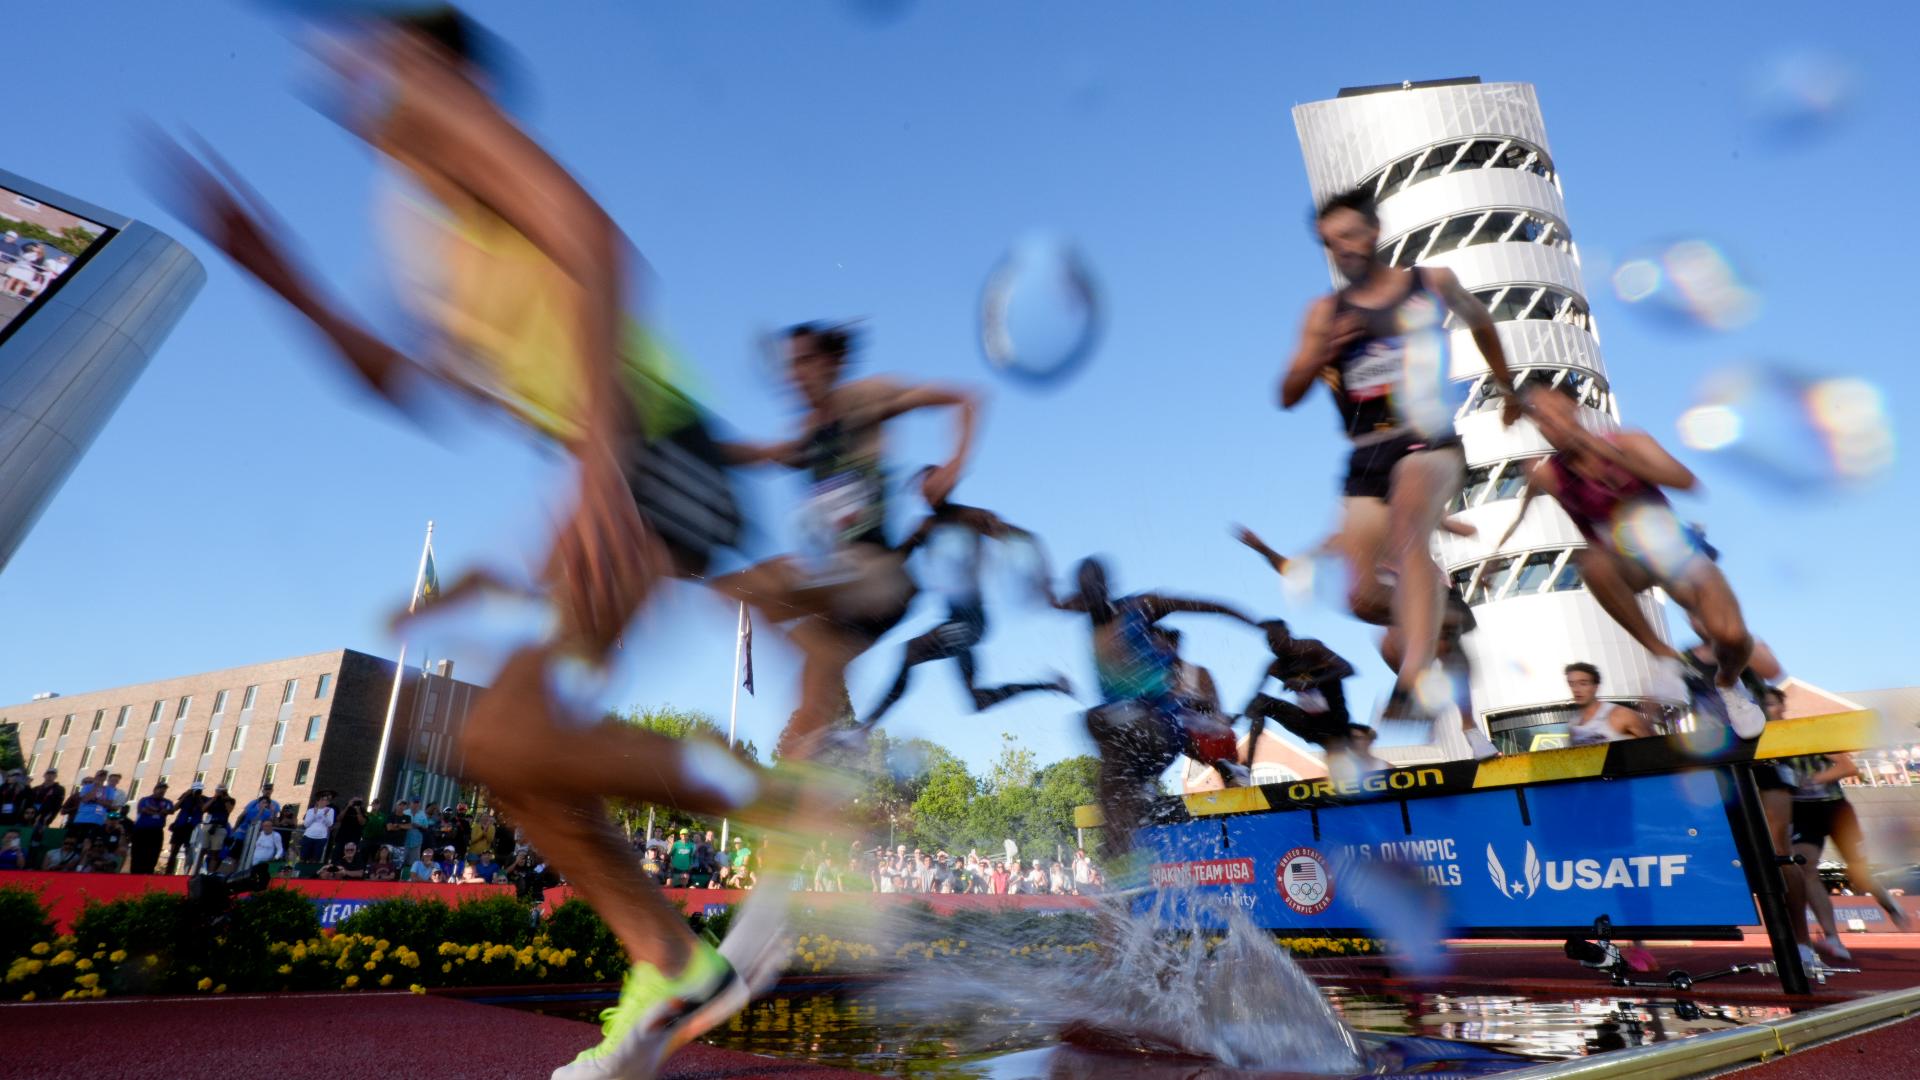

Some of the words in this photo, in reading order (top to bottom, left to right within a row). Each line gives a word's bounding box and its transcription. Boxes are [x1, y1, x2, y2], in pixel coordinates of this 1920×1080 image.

[1288, 768, 1444, 800] OREGON
[1344, 844, 1374, 860] US
[1380, 838, 1457, 862] OLYMPIC
[1193, 864, 1223, 881] TEAM
[1225, 862, 1250, 880] USA
[1545, 854, 1687, 891] USATF
[1217, 892, 1257, 910] xfiity
[322, 904, 369, 923] TEA
